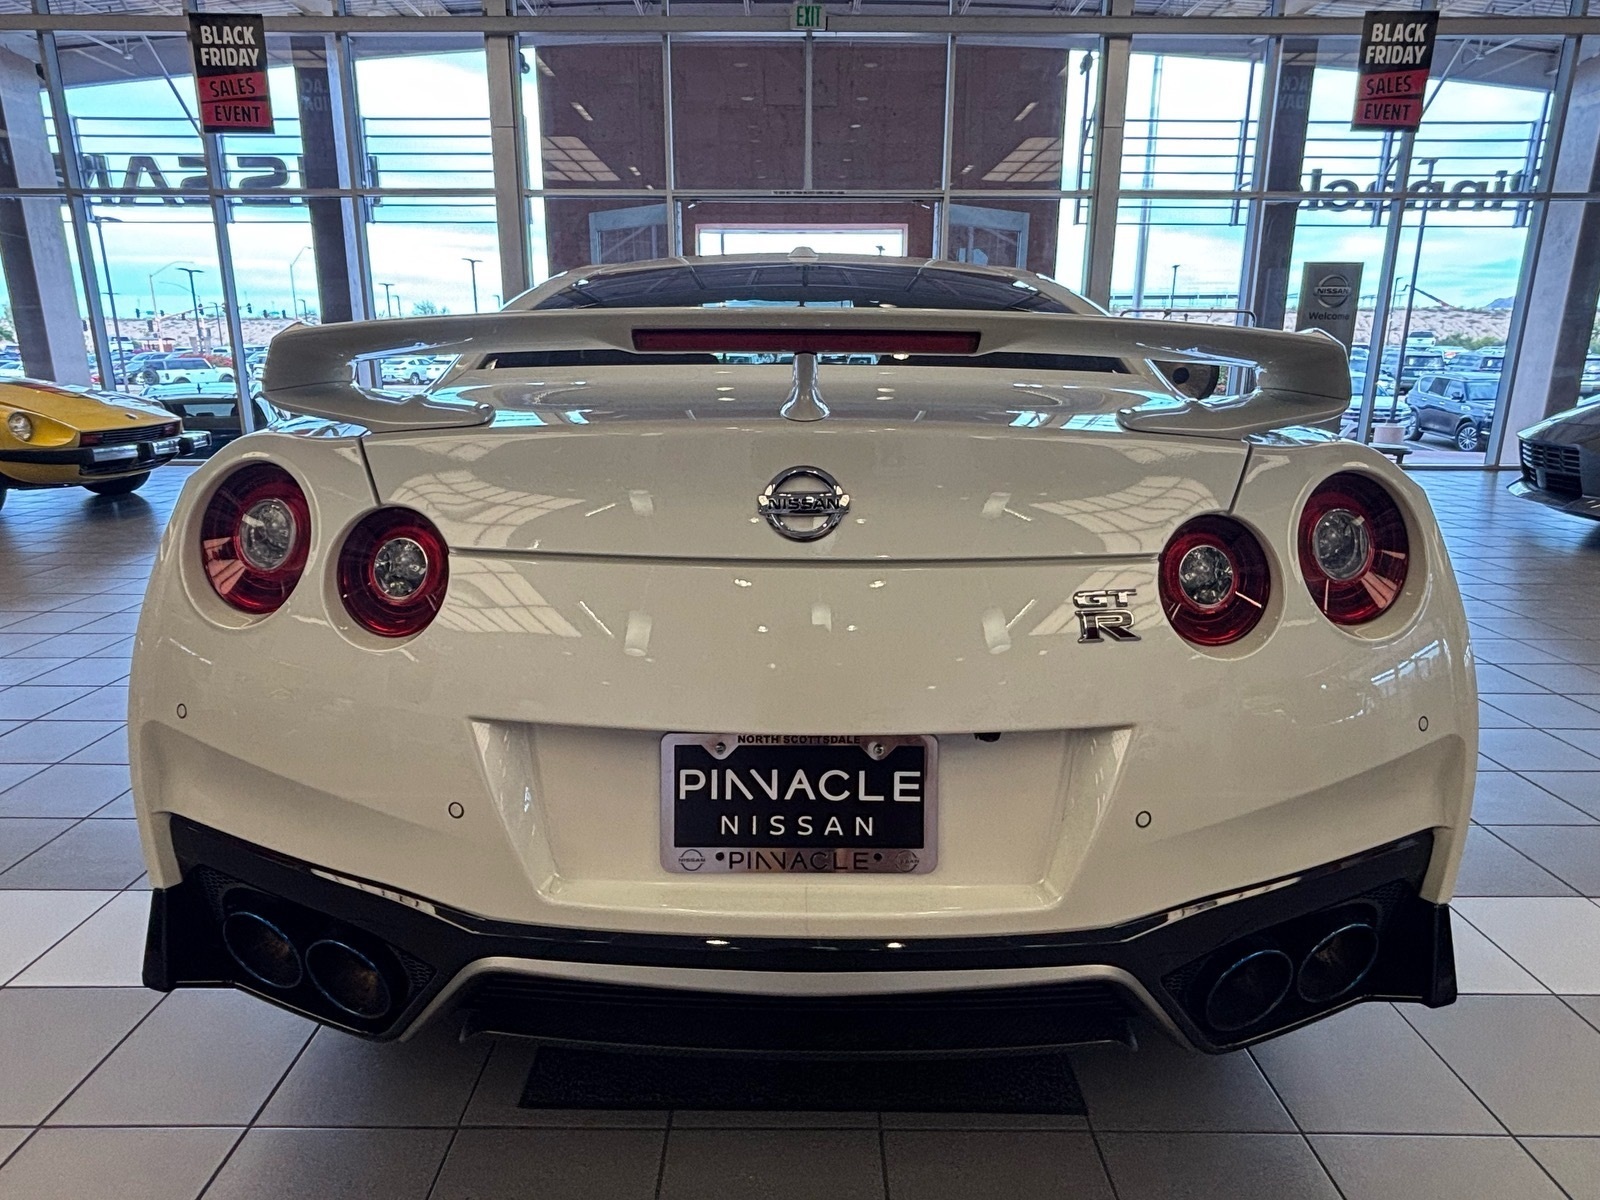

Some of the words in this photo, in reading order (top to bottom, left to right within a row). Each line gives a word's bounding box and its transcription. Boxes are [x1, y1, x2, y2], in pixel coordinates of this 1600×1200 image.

[796, 5, 822, 27] EXIT
[200, 25, 256, 45] BLACK
[1371, 23, 1427, 43] BLACK
[200, 48, 259, 67] FRIDAY
[1365, 45, 1427, 65] FRIDAY
[210, 77, 256, 98] SALES
[1366, 75, 1411, 96] SALES
[214, 105, 260, 123] EVENT
[1364, 103, 1411, 121] EVENT
[1309, 312, 1350, 320] Welcome
[768, 498, 840, 510] NISSAN
[1073, 588, 1137, 608] GT
[1075, 609, 1141, 643] R
[738, 735, 779, 744] NORTH
[783, 735, 861, 744] SCOTTSDALE
[679, 769, 921, 802] PINNACLE
[720, 815, 873, 836] NISSAN
[729, 851, 869, 870] PINNACLE
